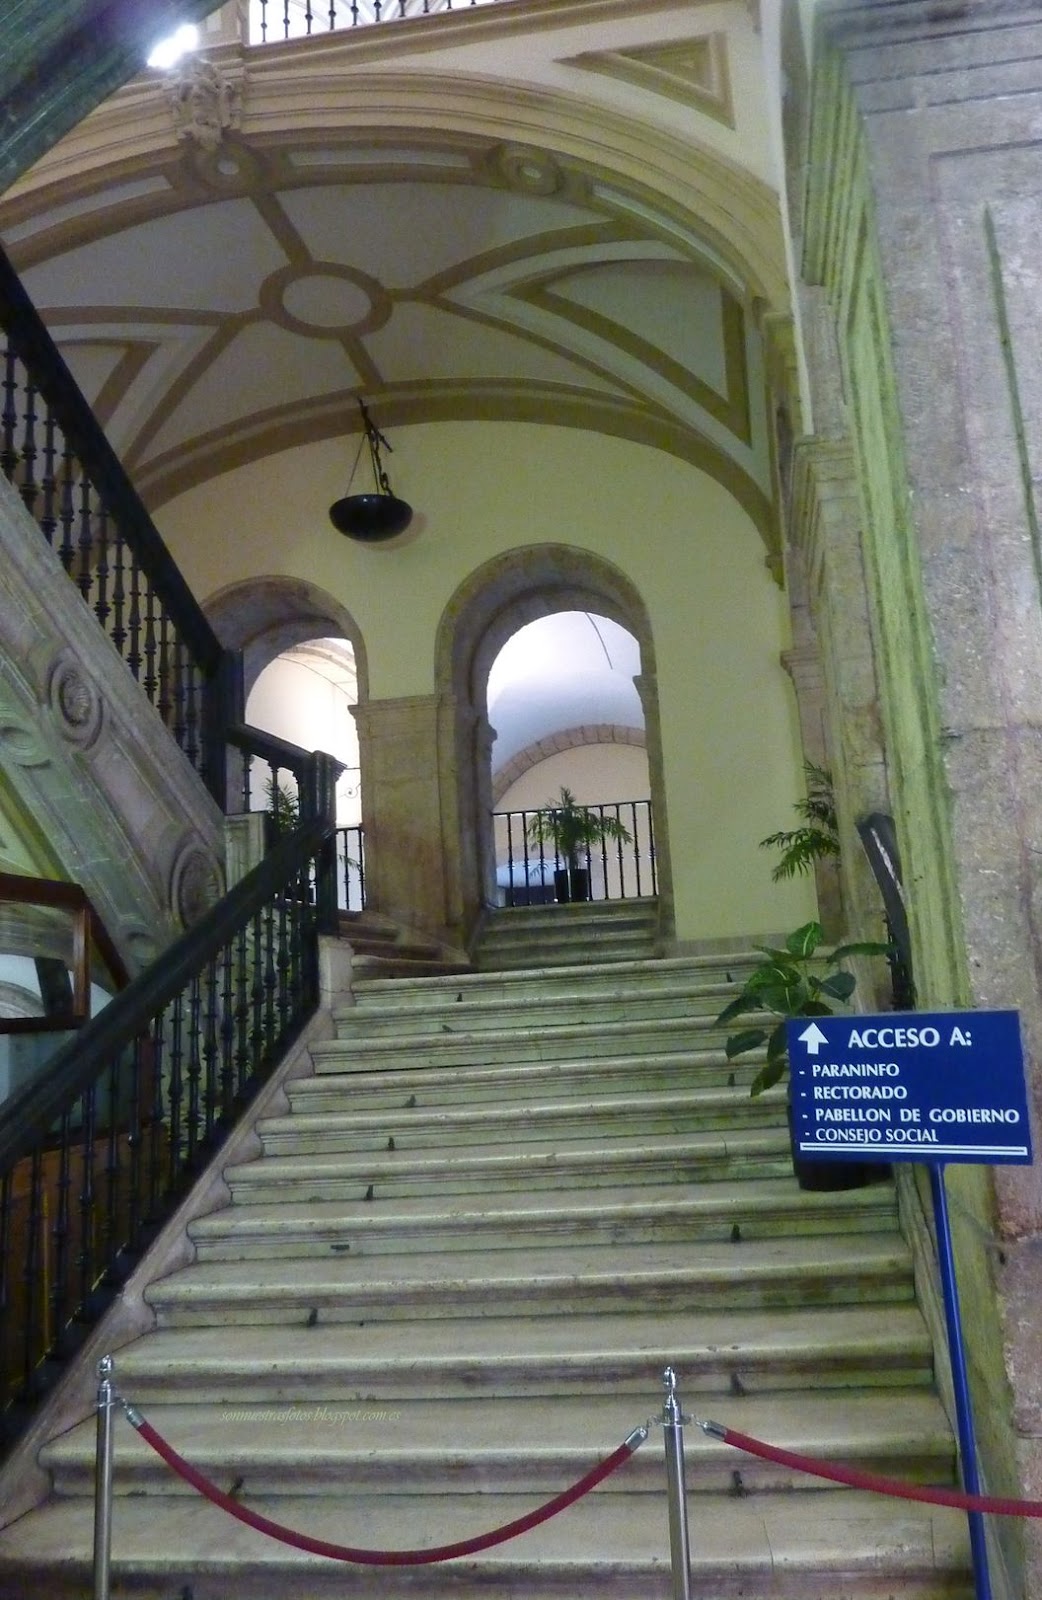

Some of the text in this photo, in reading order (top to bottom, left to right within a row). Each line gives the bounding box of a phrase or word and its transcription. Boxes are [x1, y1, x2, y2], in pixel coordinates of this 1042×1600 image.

[848, 1026, 972, 1048] ACCESO A:
[812, 1063, 900, 1077] PARANINFO
[813, 1086, 908, 1100] RECTORADO
[815, 1109, 1020, 1124] PABELLON DE GOBIERNO
[816, 1129, 939, 1144] CONSEJO SOCIAL
